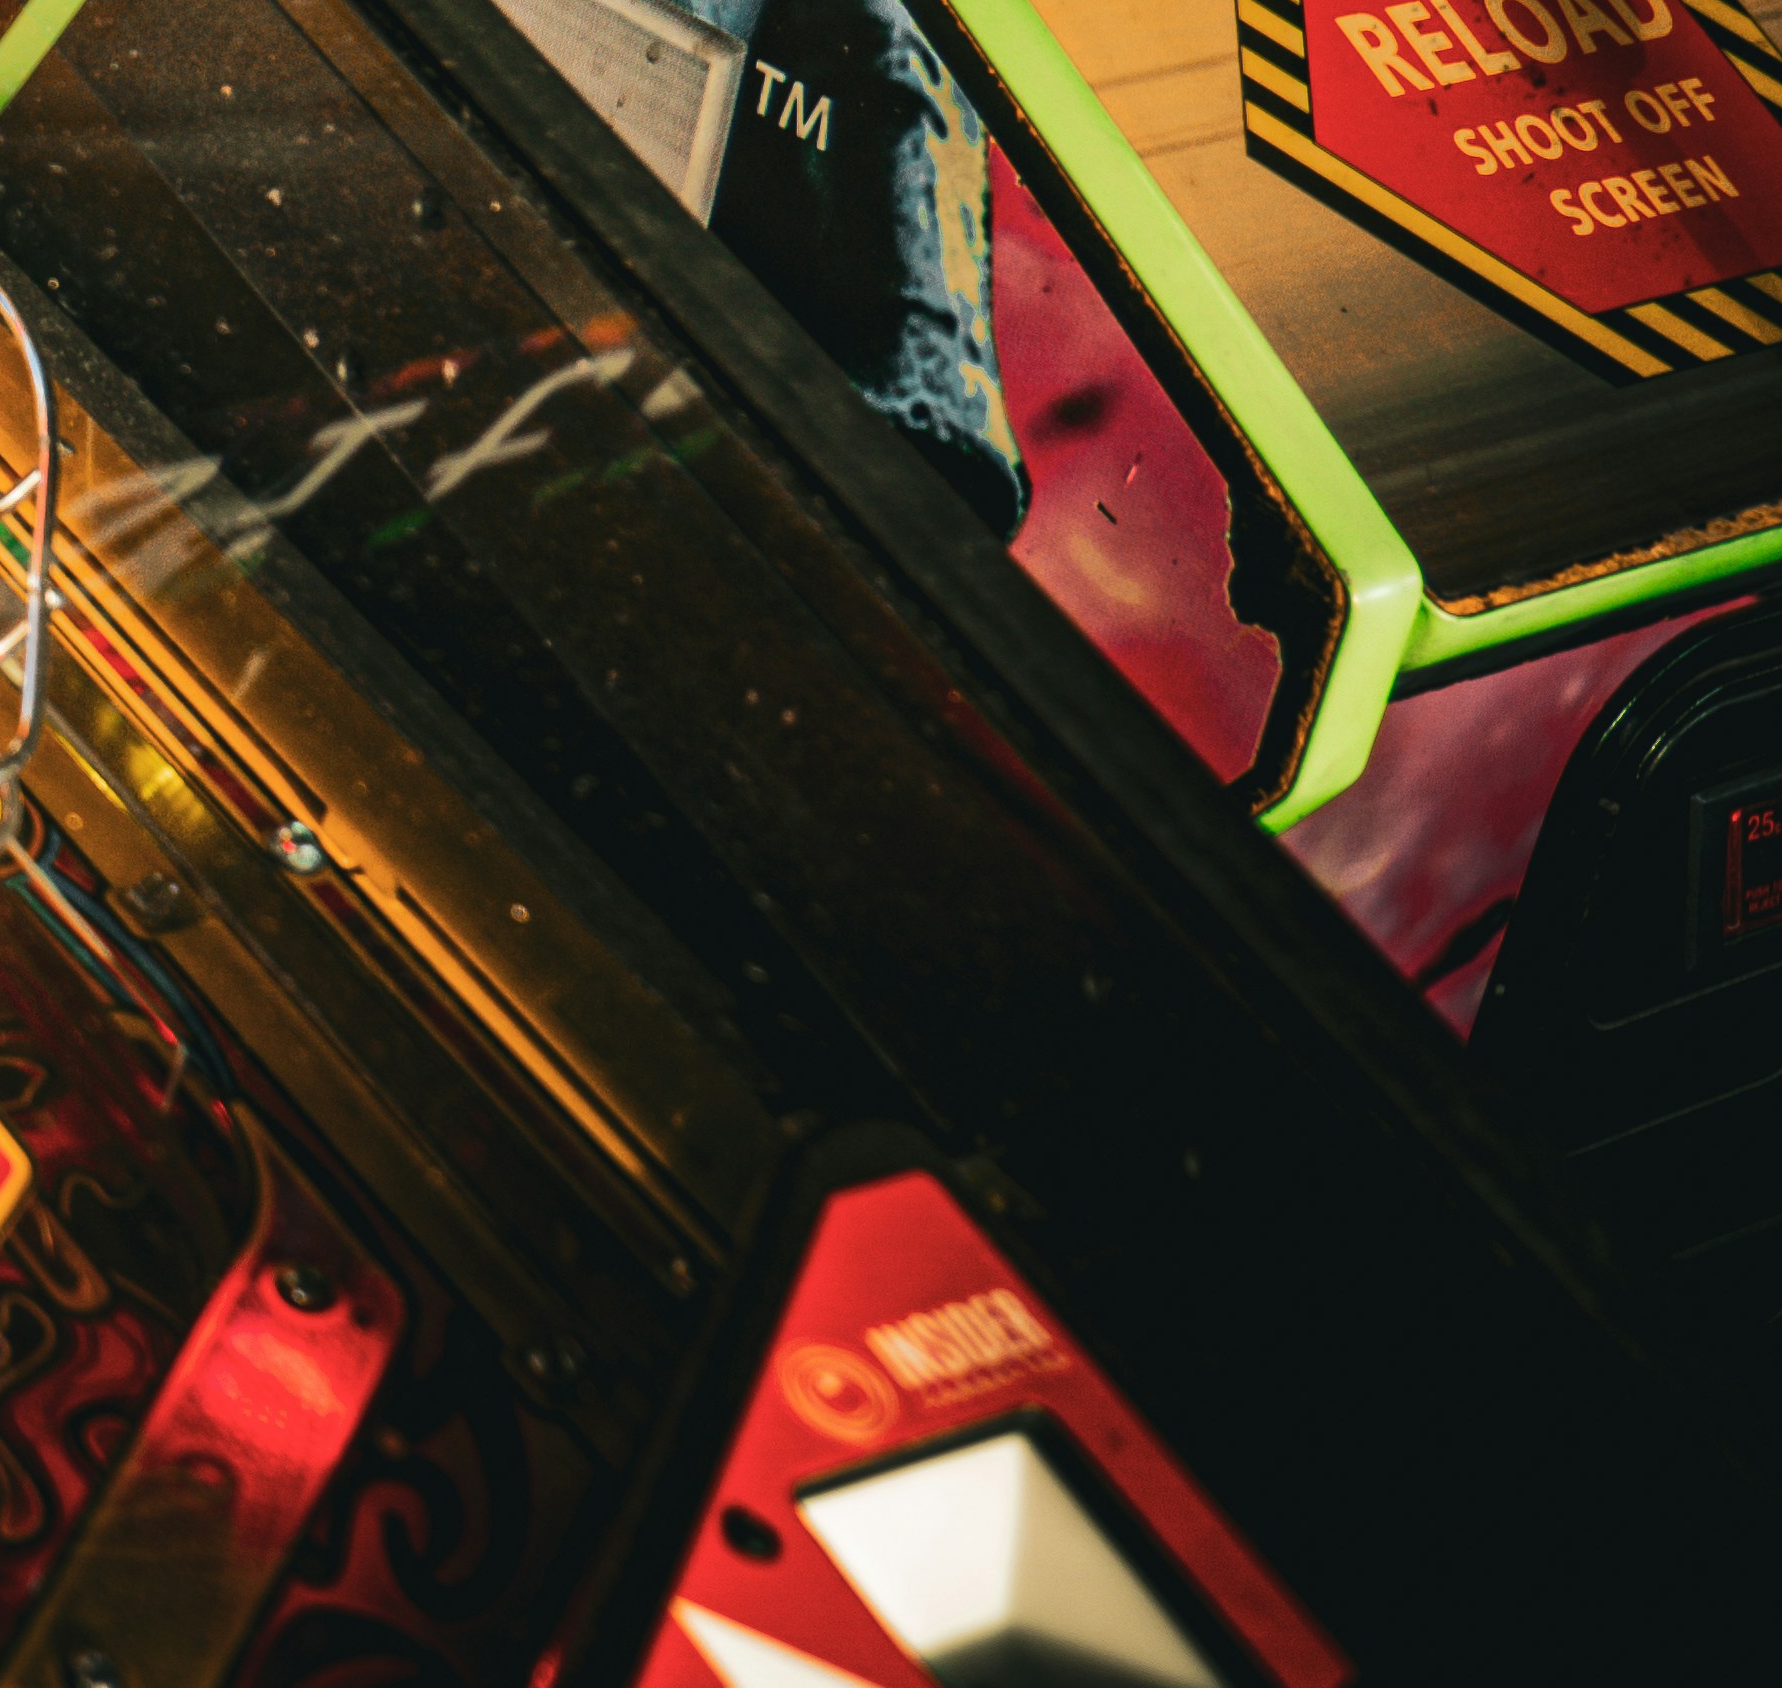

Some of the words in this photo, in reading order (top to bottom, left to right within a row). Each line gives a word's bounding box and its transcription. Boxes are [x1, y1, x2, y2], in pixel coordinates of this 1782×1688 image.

[756, 59, 832, 152] TM
[1453, 100, 1624, 177] SHOOT
[1624, 77, 1716, 135] OFF
[1549, 155, 1740, 238] SCREEN
[863, 1287, 1054, 1391] INSIDER
